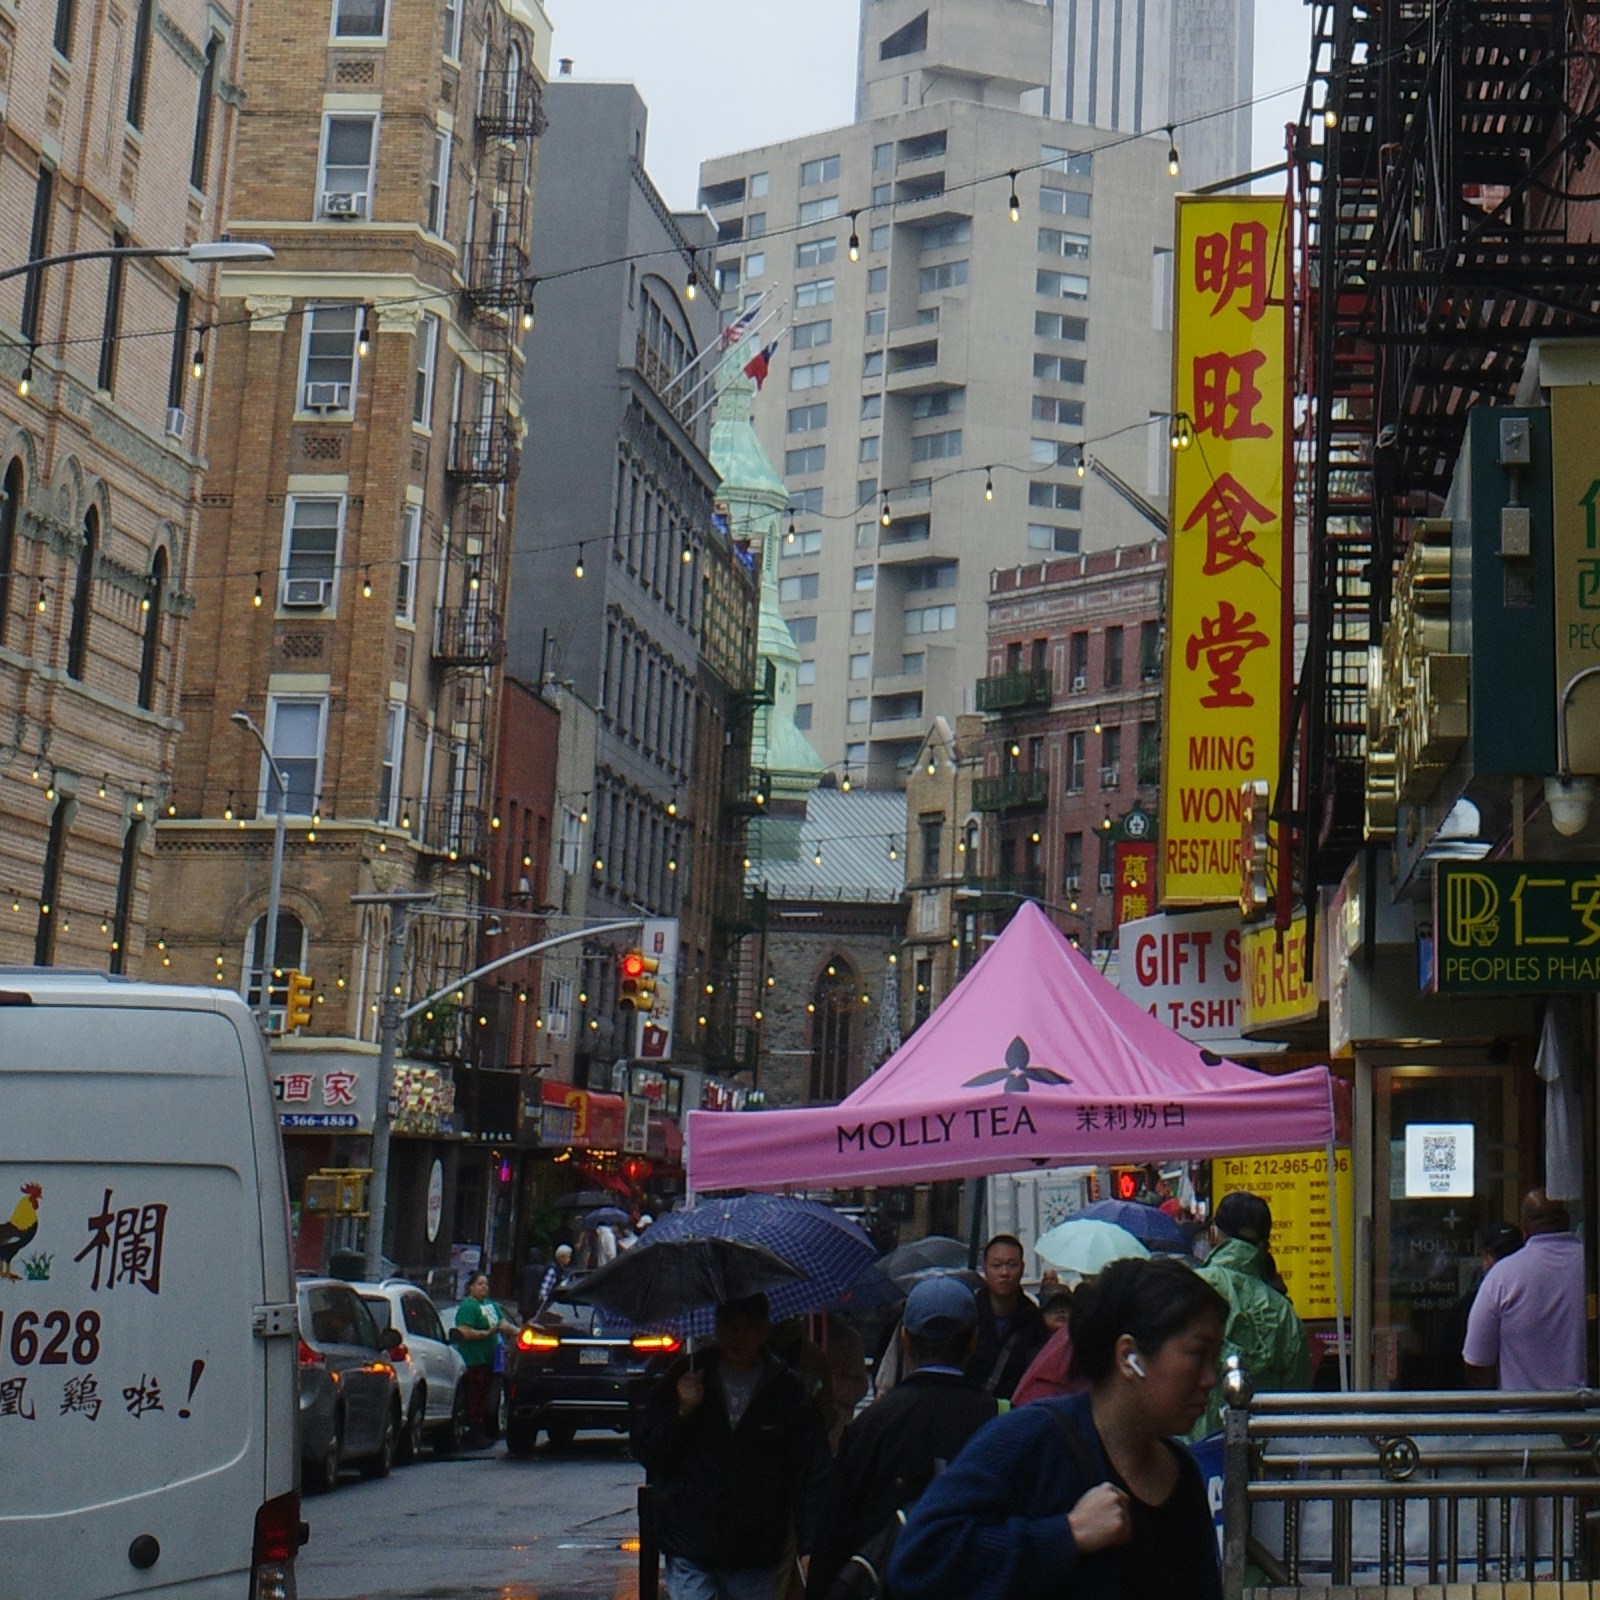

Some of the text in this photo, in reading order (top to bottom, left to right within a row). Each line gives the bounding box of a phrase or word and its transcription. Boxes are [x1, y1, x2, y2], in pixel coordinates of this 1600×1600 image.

[1183, 220, 1277, 708] 明旺食堂
[1188, 735, 1255, 771] MING
[1180, 787, 1242, 824] WON
[1167, 838, 1243, 876] RESTAUR
[1135, 931, 1212, 987] GIFT
[1446, 957, 1541, 983] PEOPLES
[1168, 1002, 1241, 1029] T-SHI
[836, 1106, 1037, 1153] MOLLY TEA
[1076, 1102, 1186, 1132] 茉莉奶白
[1224, 1161, 1248, 1175] Tel:
[1248, 1181, 1273, 1191] SLICED
[1275, 1181, 1296, 1191] PORK
[74, 1188, 168, 1295] 欄
[0, 1309, 101, 1366] 628
